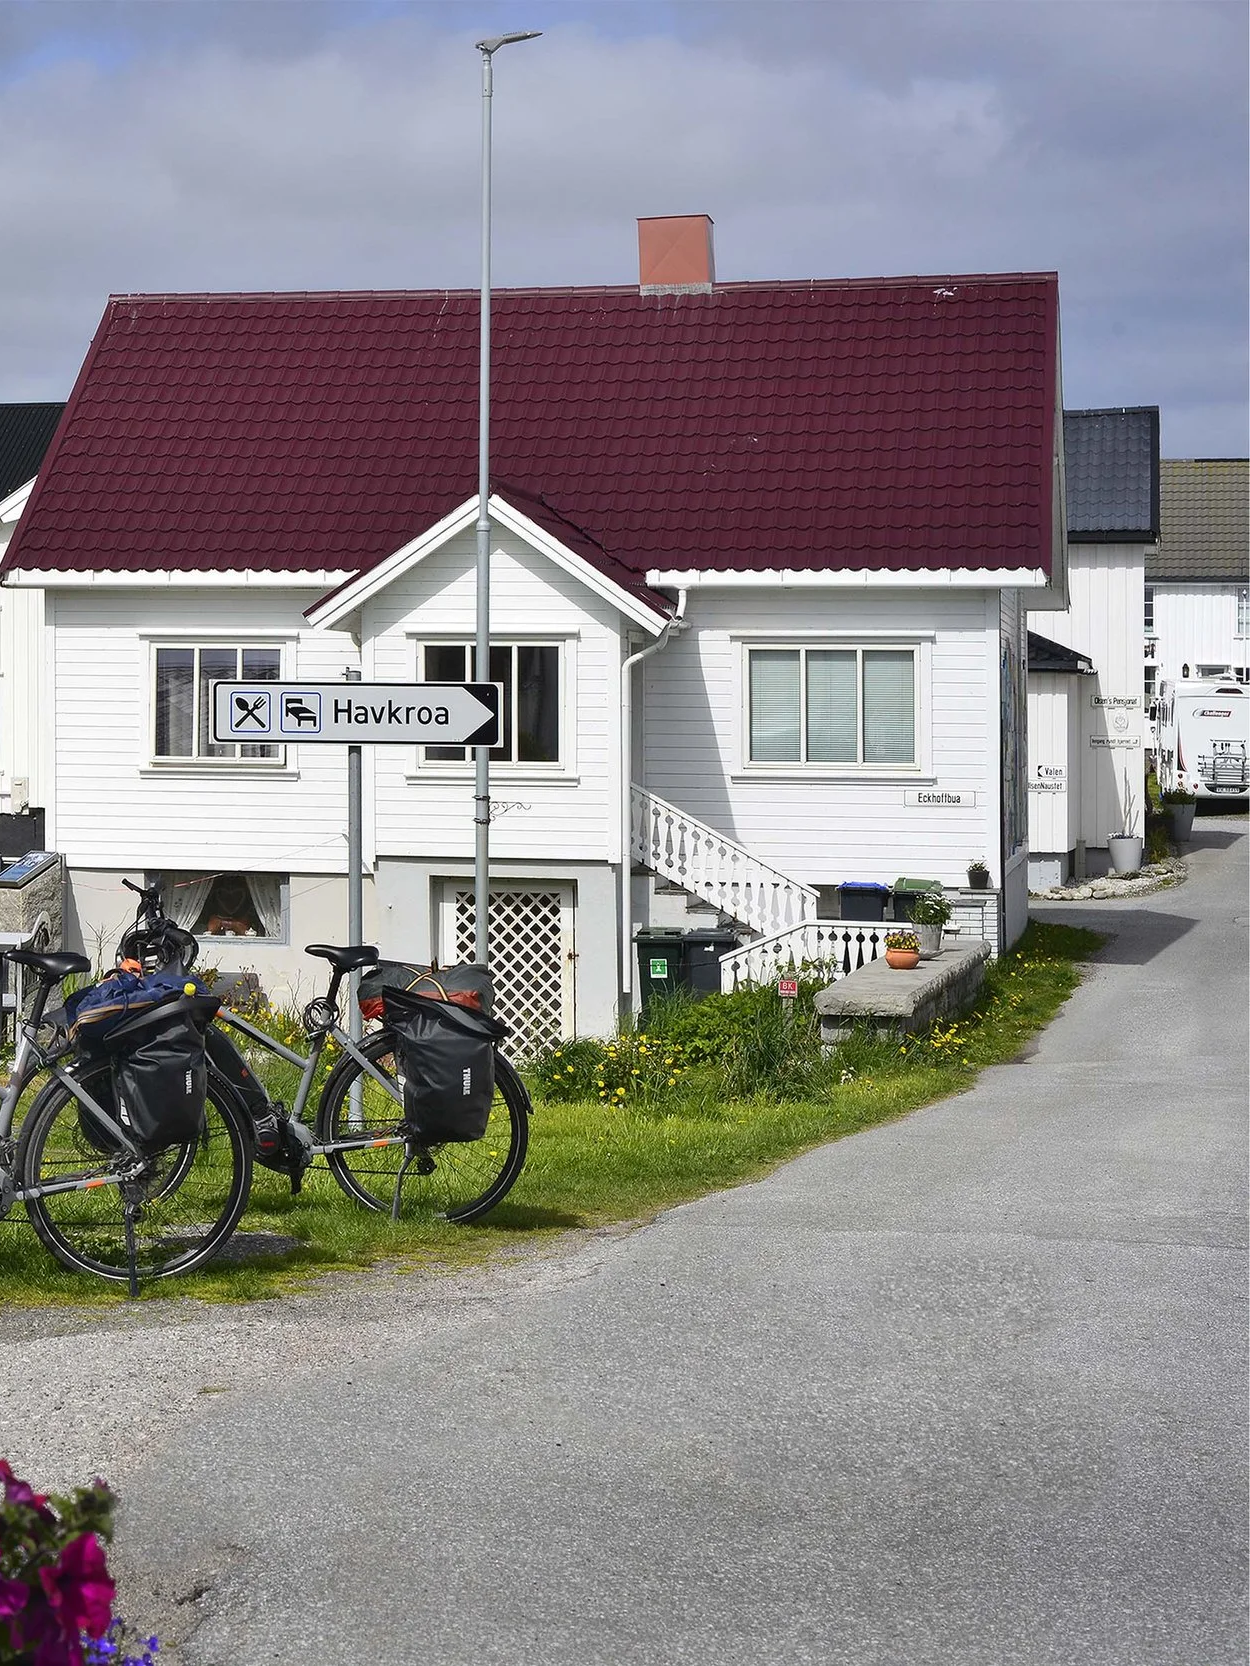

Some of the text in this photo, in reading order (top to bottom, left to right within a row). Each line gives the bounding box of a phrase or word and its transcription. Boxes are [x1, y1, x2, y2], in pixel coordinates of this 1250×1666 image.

[333, 698, 450, 725] Havkroa
[1045, 767, 1063, 776] Valen
[1028, 782, 1063, 790] lsenNaustet
[918, 792, 961, 803] Eckhoffbua
[185, 1069, 193, 1095] THULE
[463, 1067, 471, 1096] THULE
